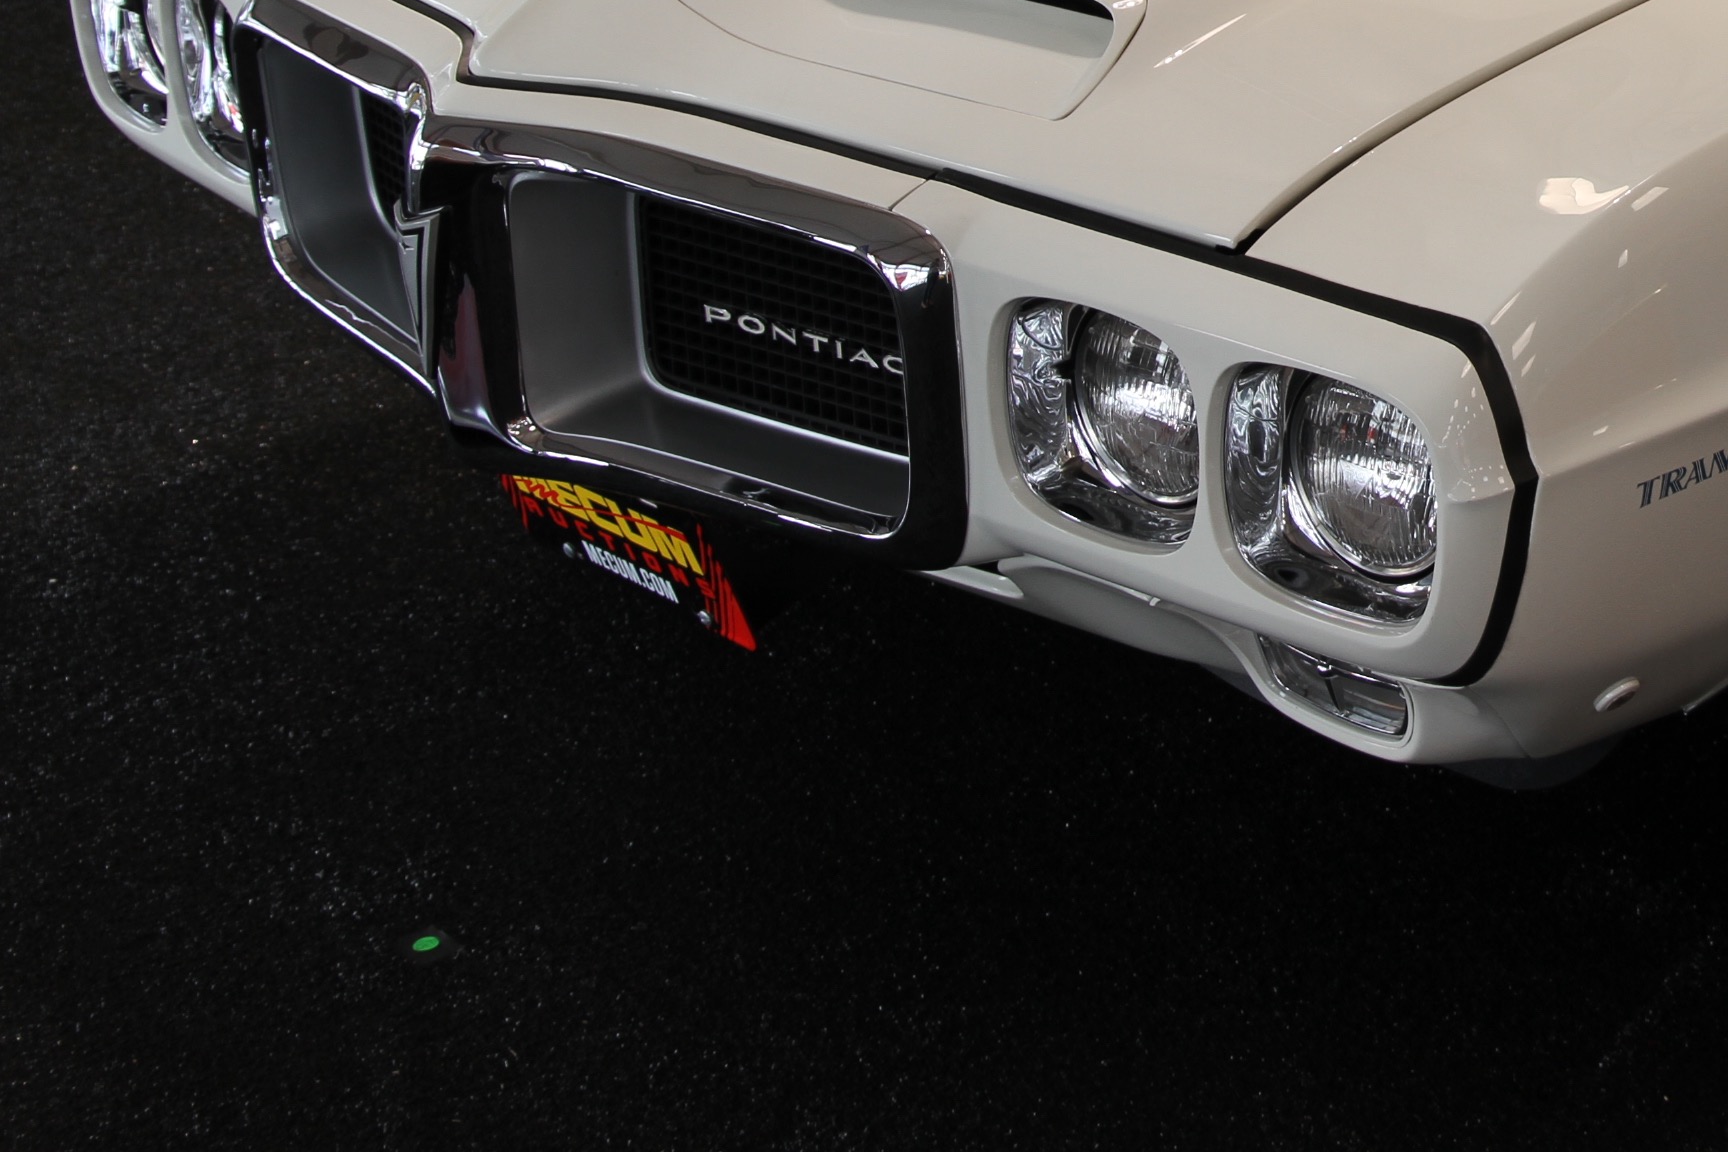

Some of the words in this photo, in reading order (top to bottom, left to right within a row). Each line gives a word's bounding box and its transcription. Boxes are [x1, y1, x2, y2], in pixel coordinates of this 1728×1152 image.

[704, 304, 904, 375] PONTIAC
[521, 494, 716, 599] AUCTIONS
[581, 539, 679, 604] MECUM.COM
